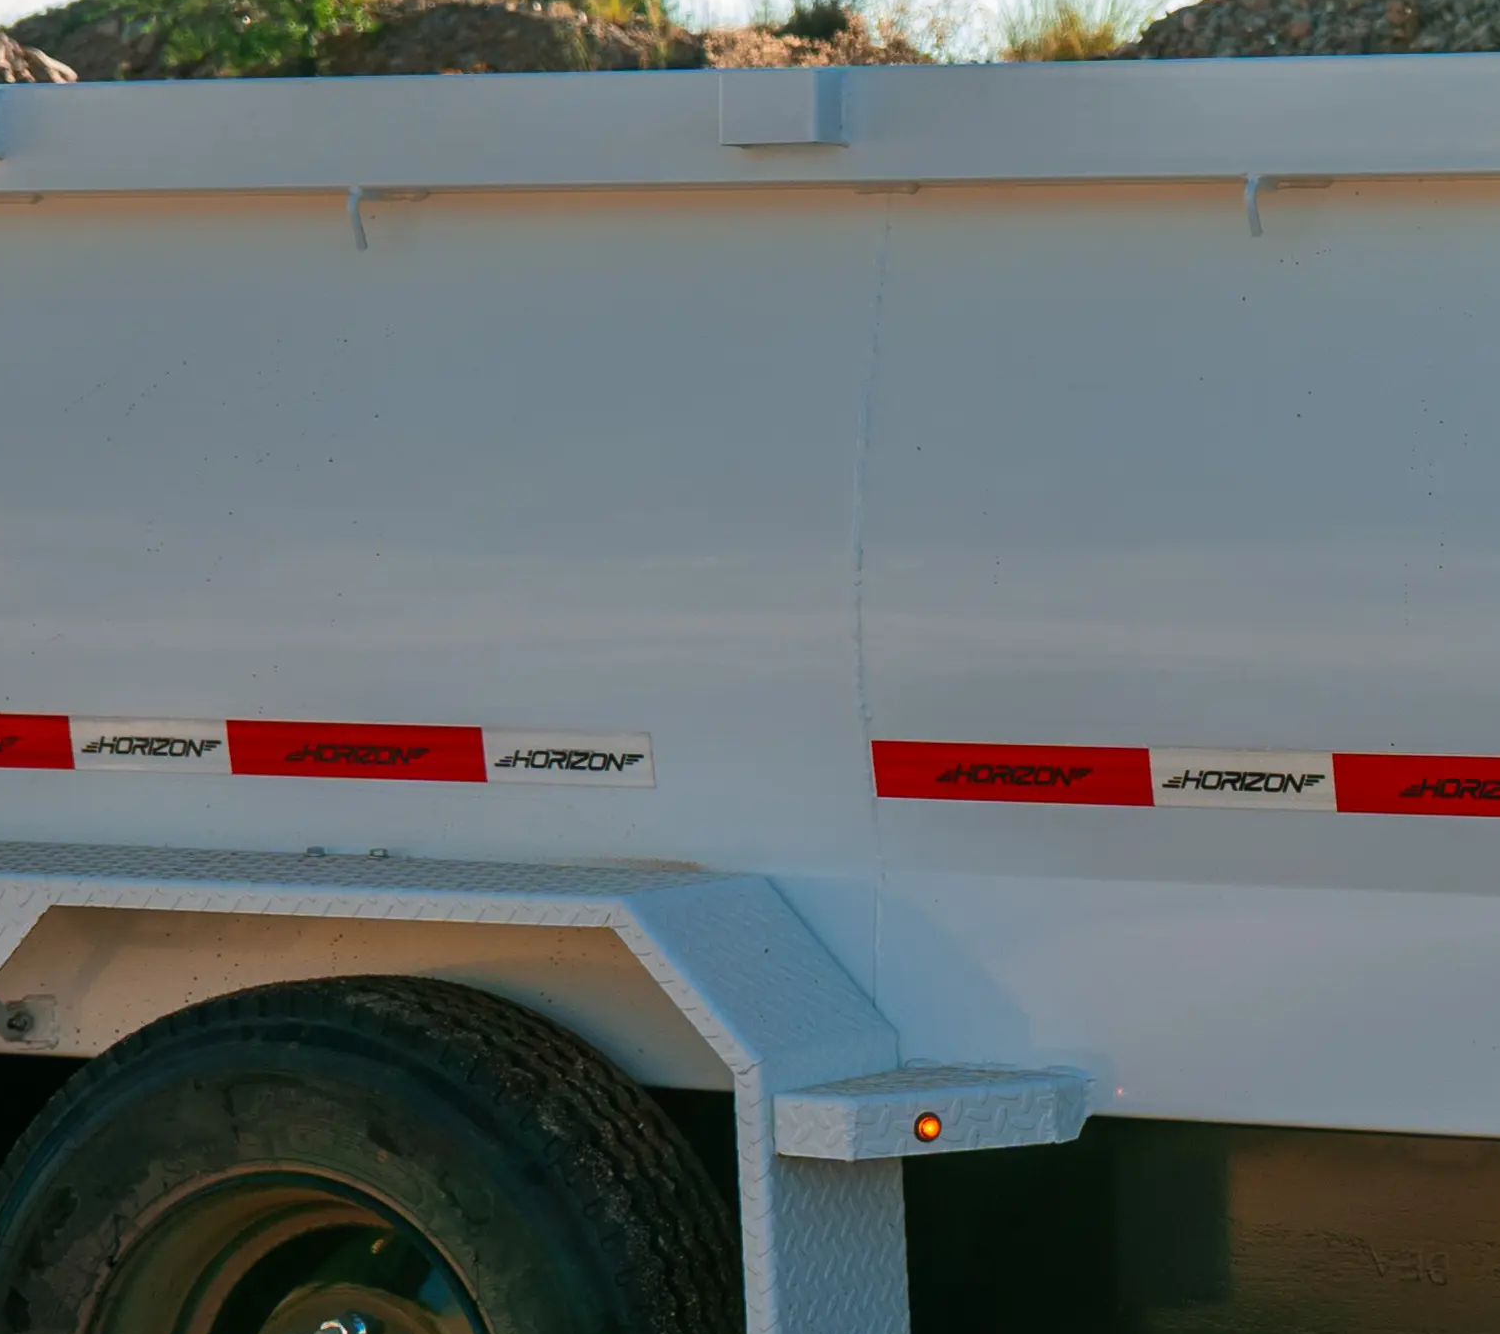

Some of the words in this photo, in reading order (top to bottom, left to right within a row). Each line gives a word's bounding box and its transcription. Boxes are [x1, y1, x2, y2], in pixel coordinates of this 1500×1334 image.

[98, 735, 209, 758] HORIZON
[511, 750, 629, 772] HORIZON
[953, 763, 1078, 787] HORIZON
[1180, 769, 1309, 793] HORIZON
